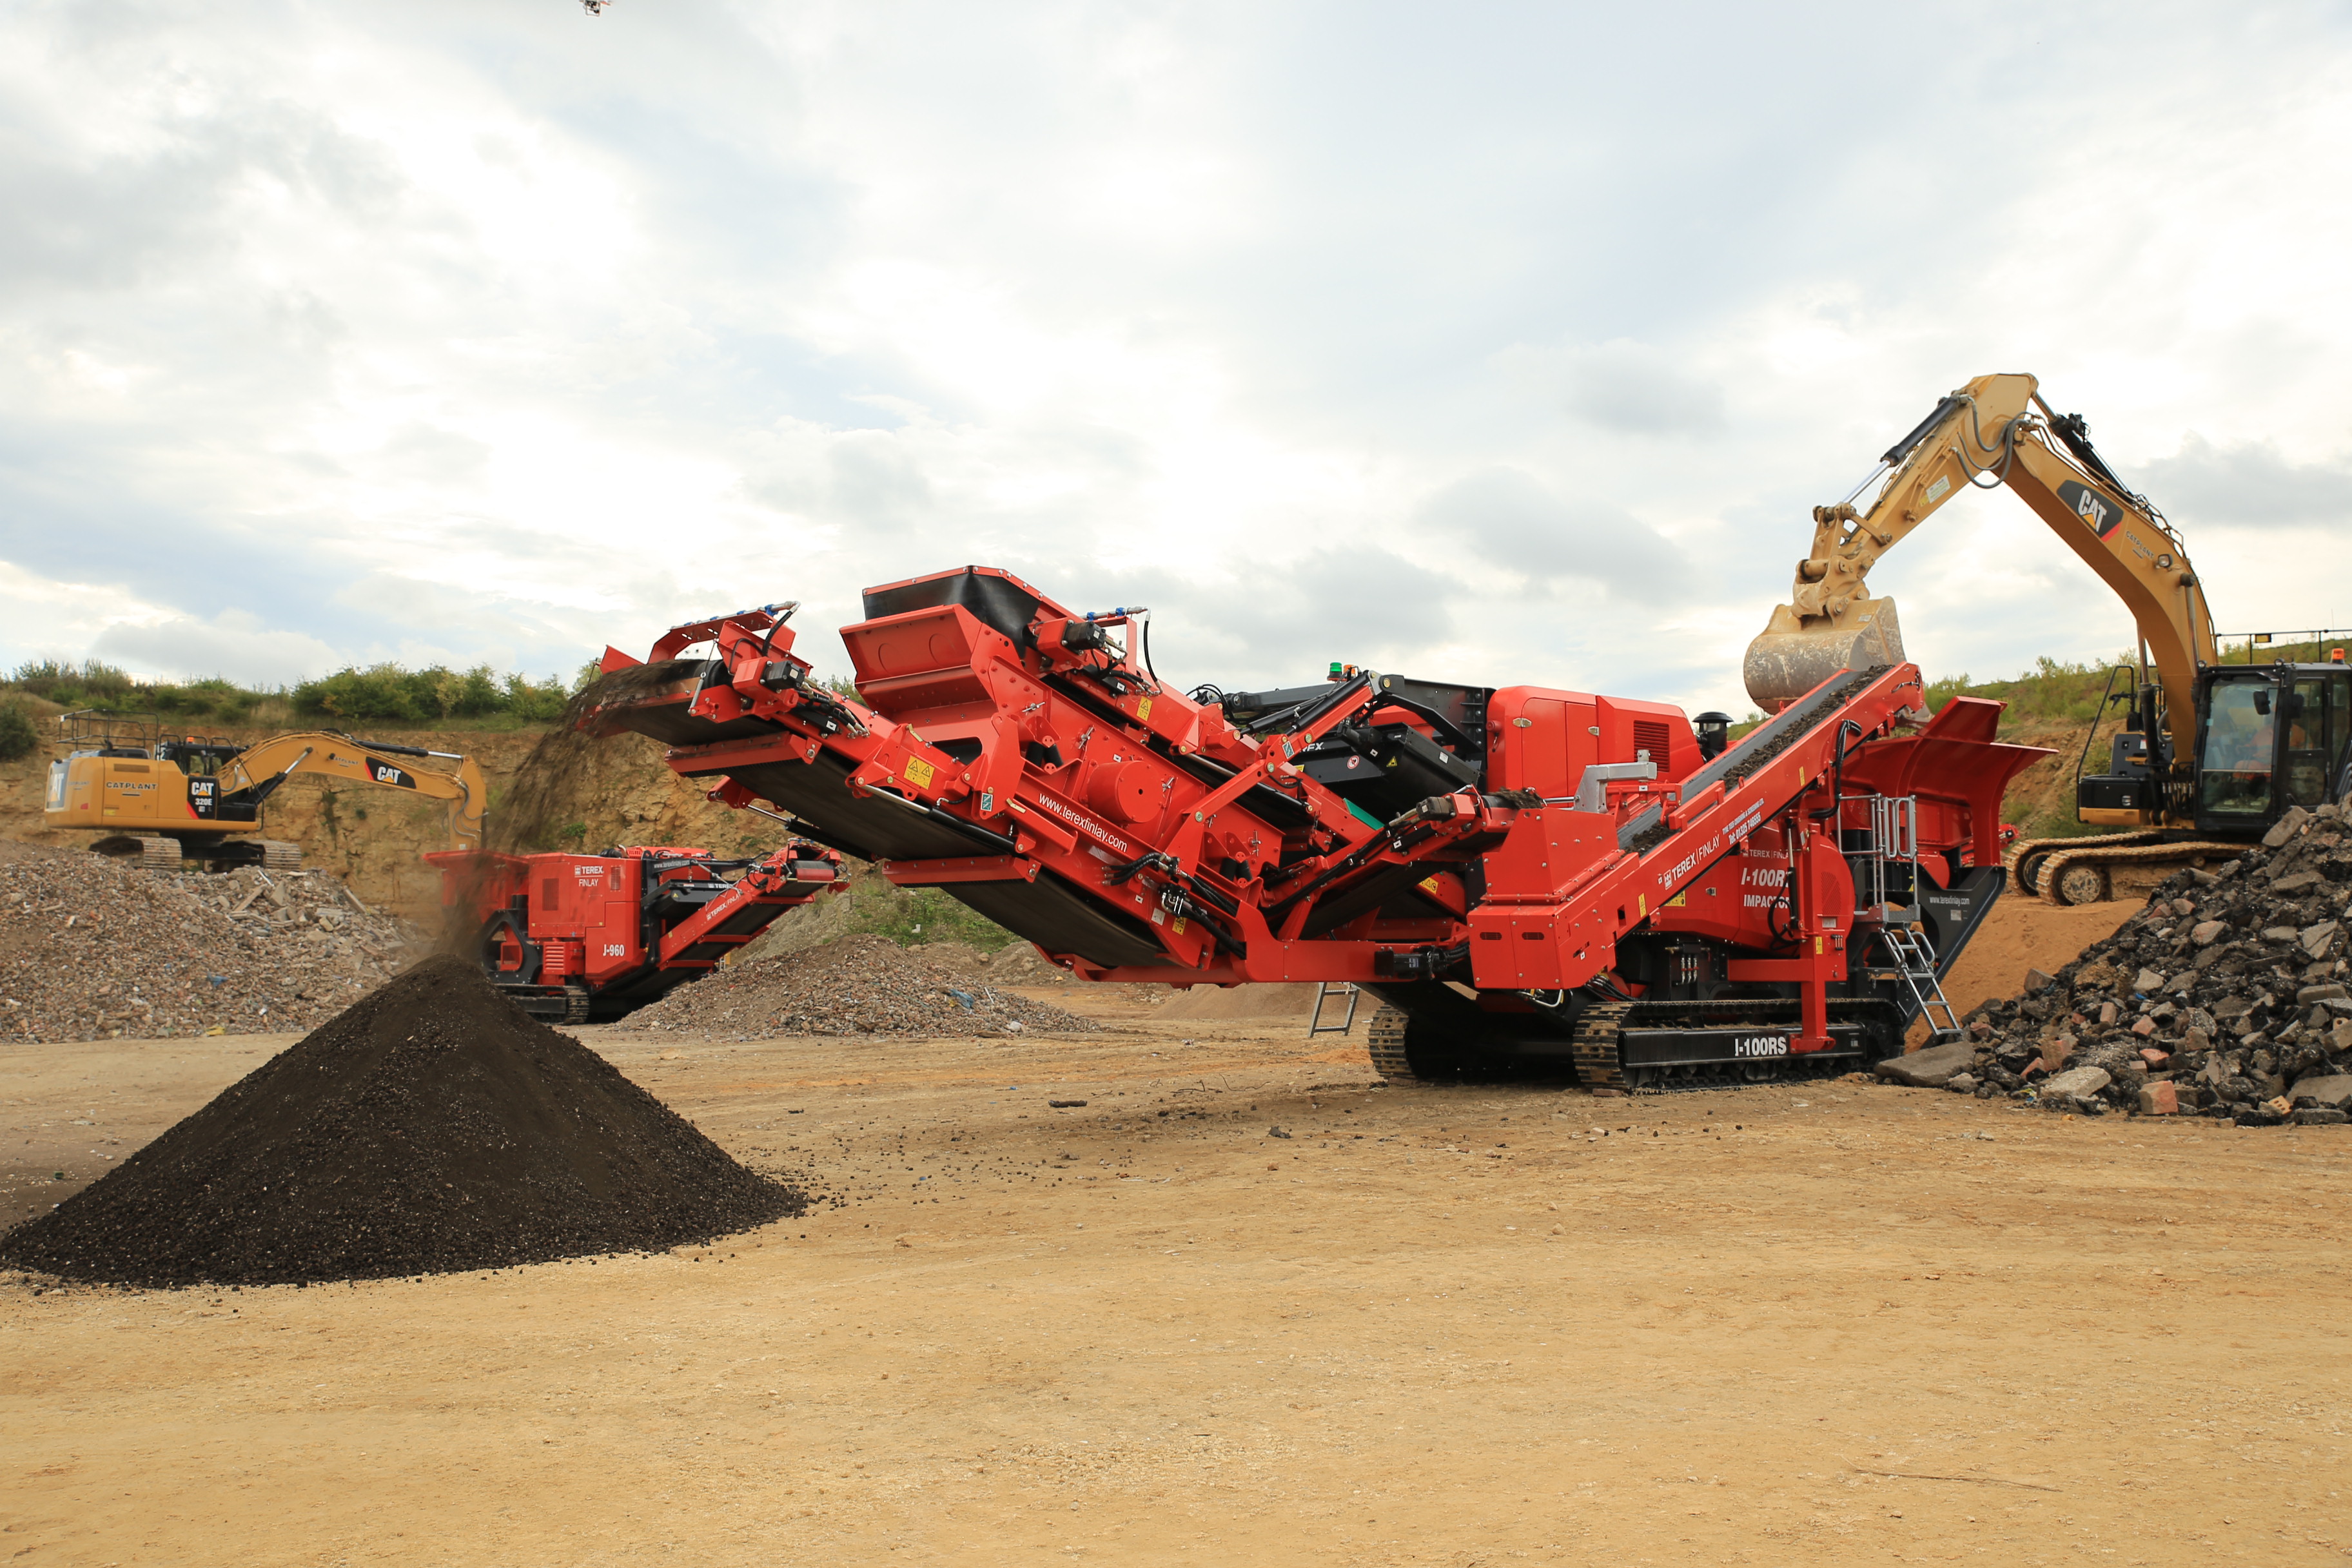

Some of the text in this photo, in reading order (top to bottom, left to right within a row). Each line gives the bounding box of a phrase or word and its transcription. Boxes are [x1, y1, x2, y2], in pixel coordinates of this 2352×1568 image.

[2078, 489, 2107, 532] CAT
[2126, 531, 2154, 559] CATPLANT
[333, 756, 358, 765] ATPLANT
[377, 766, 401, 784] CAT
[106, 781, 157, 790] CATPLANT
[191, 781, 214, 796] CAT
[195, 798, 213, 806] 320E
[1039, 793, 1127, 852] www.terexfinlay.com
[1672, 834, 1720, 881] TEREX FINLAY
[1749, 849, 1789, 859] TEREX FINLA
[582, 865, 603, 874] TEREX
[1741, 867, 1788, 888] I-100R
[578, 878, 599, 887] FINLAY
[711, 894, 740, 916] TEREX FINLA
[603, 944, 625, 957] J-960
[1734, 1036, 1787, 1057] I-100RS
